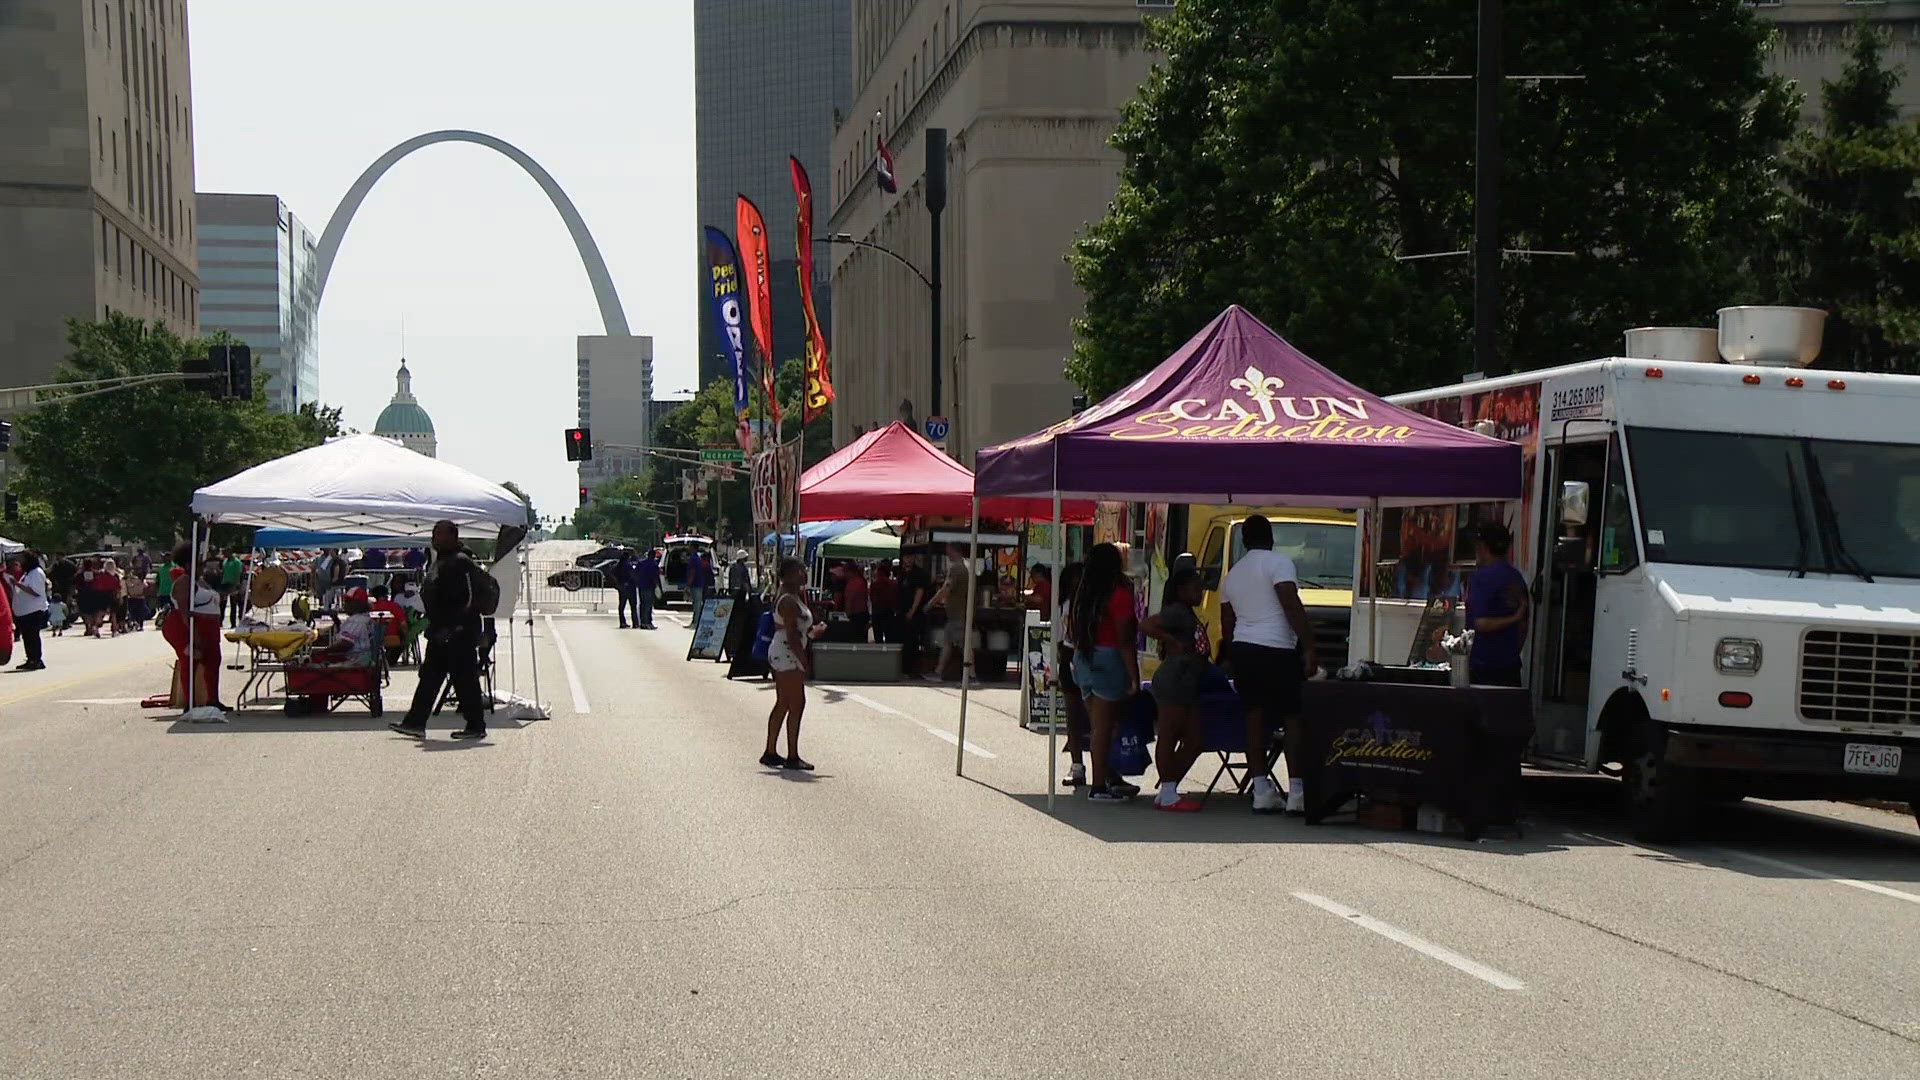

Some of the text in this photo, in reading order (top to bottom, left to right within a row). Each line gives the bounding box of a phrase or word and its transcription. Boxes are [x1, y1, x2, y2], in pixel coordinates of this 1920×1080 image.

[1552, 385, 1605, 408] 314.265.0813
[1168, 396, 1370, 425] CAJUN
[929, 423, 945, 436] 70
[1110, 411, 1417, 440] Seduction
[702, 451, 732, 460] Tucker
[1325, 737, 1432, 766] Seduction
